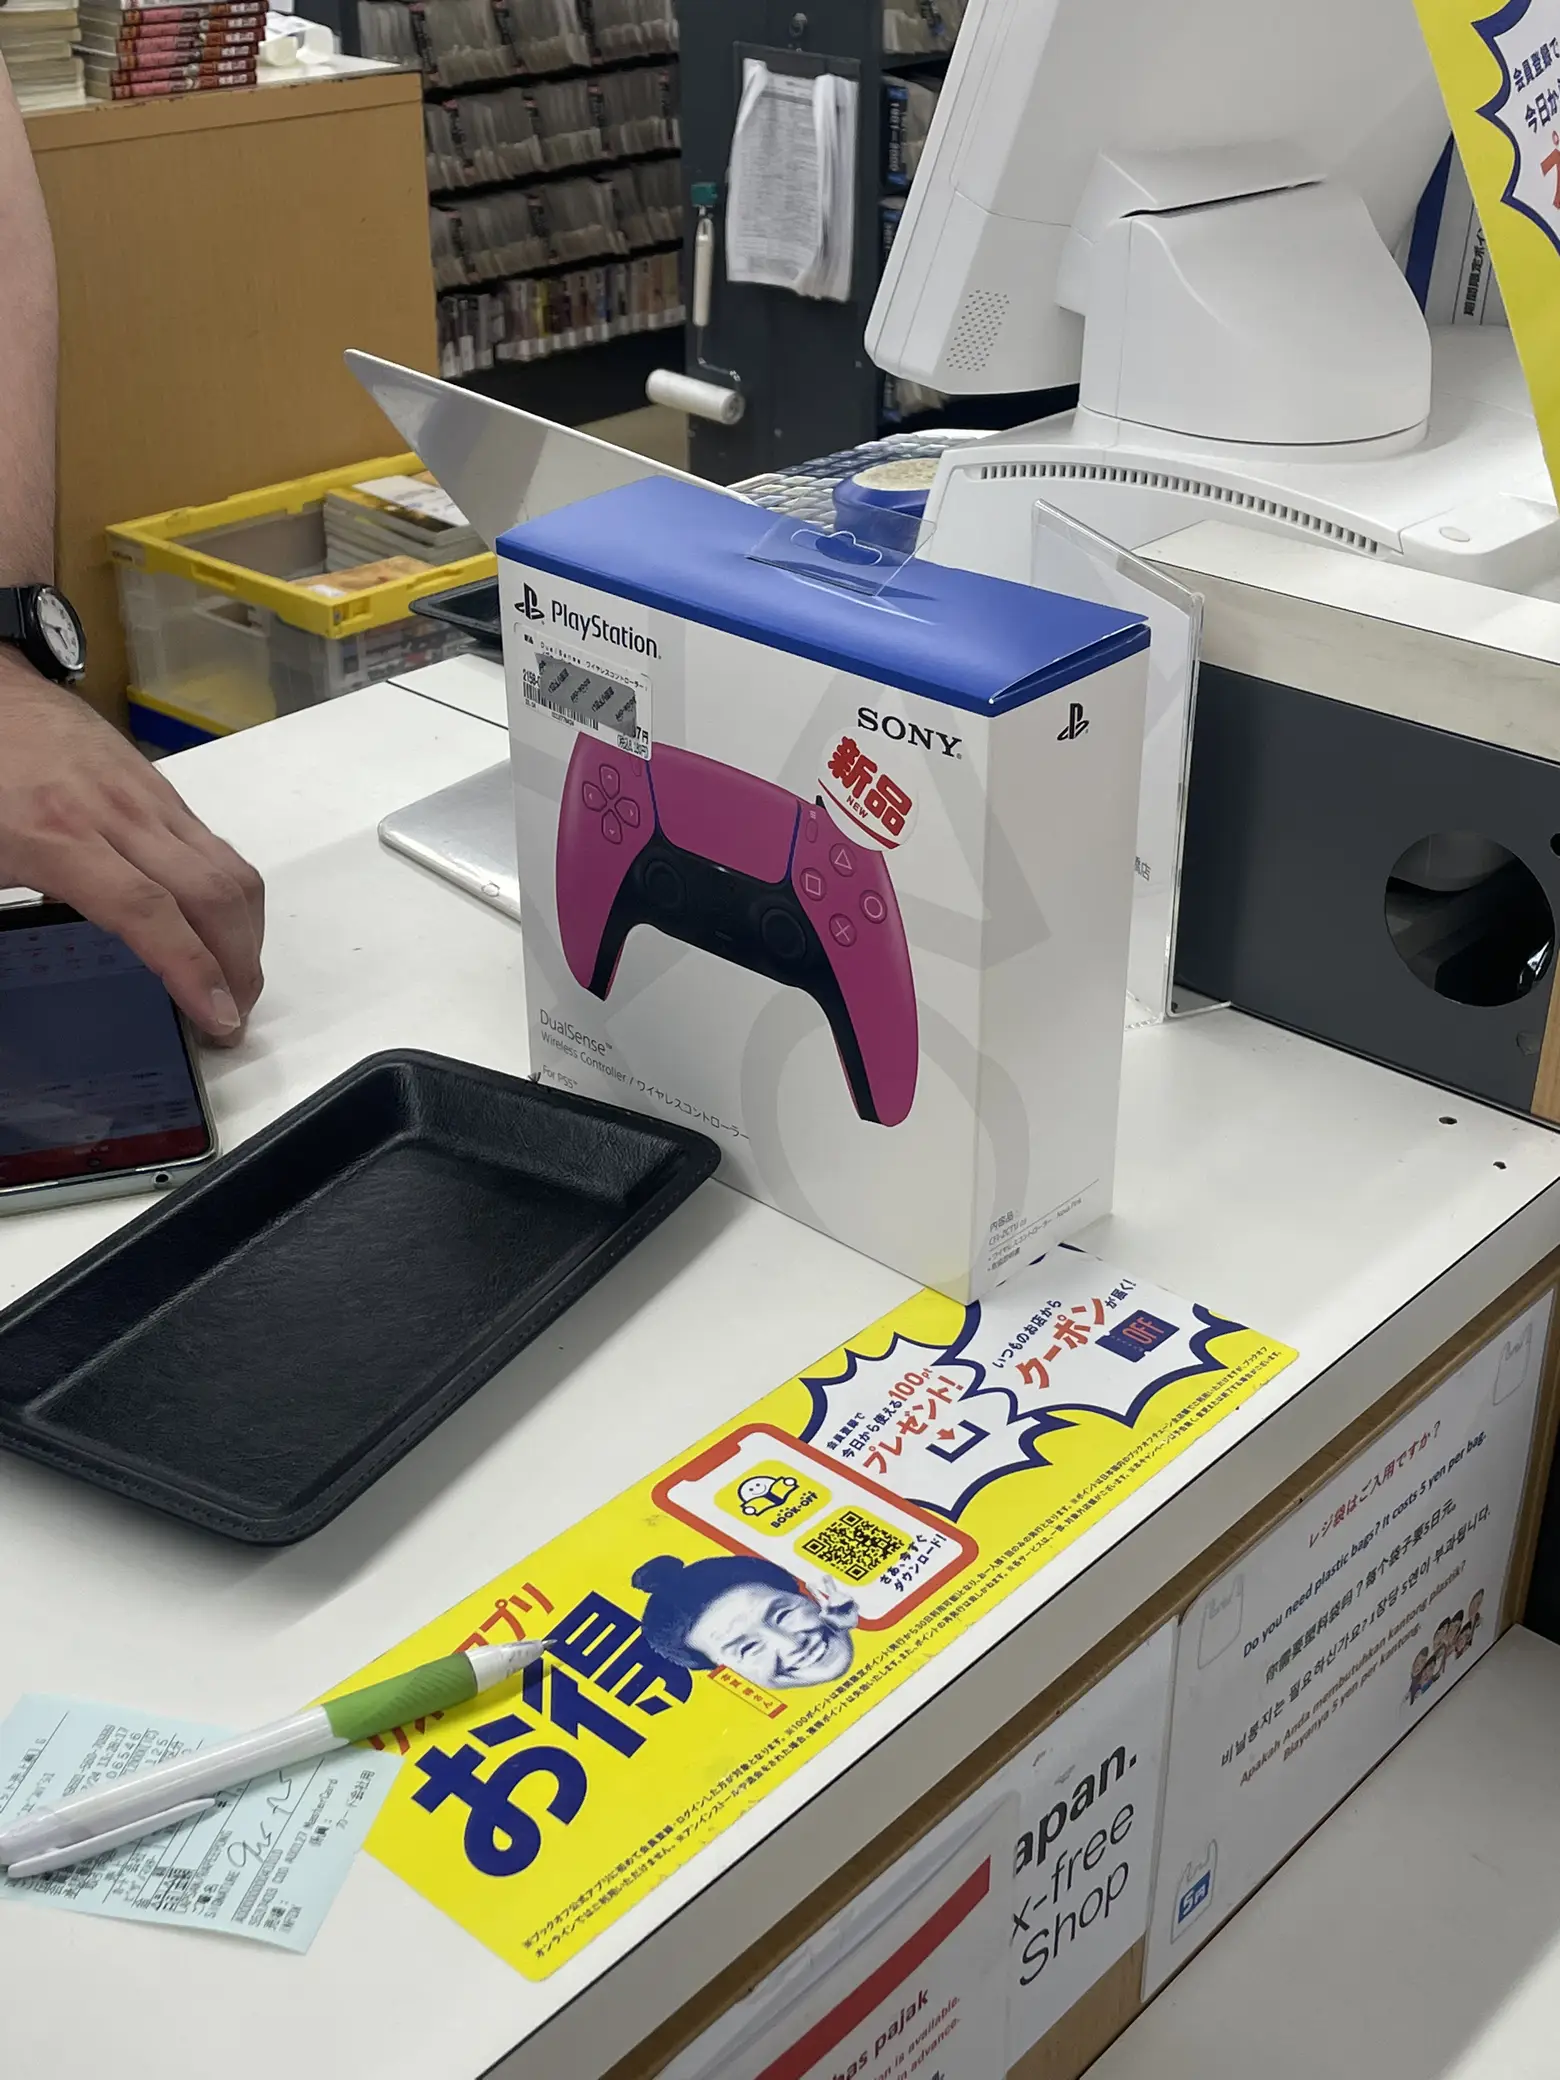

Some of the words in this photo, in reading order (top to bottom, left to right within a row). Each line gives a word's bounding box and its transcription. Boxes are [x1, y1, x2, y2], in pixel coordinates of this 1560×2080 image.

[1525, 78, 1560, 133] 今日か
[1463, 226, 1486, 316] 期間限定ポイ
[551, 599, 660, 660] PlayStation
[857, 706, 962, 758] SONY
[827, 735, 913, 837] 新品
[846, 793, 869, 819] NEW
[540, 1030, 578, 1060] Wireless
[579, 1050, 628, 1084] Controller
[636, 1080, 750, 1140] ワイヤレスコントローラー
[541, 1064, 556, 1081] For
[992, 1300, 1062, 1369] いつものお店から
[1122, 1316, 1165, 1345] OFF
[826, 1412, 866, 1451] 会員登録で
[771, 1491, 819, 1529] BOOK-OFF
[880, 1533, 928, 1585] さあ、今すぐ
[1243, 1638, 1259, 1659] Do
[1261, 1613, 1283, 1645] you
[1285, 1582, 1313, 1620] need
[1314, 1549, 1350, 1597] plastic
[1351, 1521, 1380, 1558] bags?
[1391, 1490, 1418, 1521] costs
[1419, 1480, 1428, 1496] 5
[1428, 1464, 1446, 1491] yen
[1447, 1447, 1466, 1474] per
[1466, 1430, 1487, 1456] bag.
[1239, 1740, 1281, 1788] Apakah
[1283, 1709, 1312, 1745] Anda
[1388, 1594, 1429, 1639] kantong
[1282, 1708, 1331, 1763] Biayanya
[1339, 1680, 1359, 1708] yen
[1359, 1661, 1379, 1690] per
[411, 1590, 693, 1877] お得
[1020, 1862, 1130, 1987] Shop
[874, 1988, 929, 2060] pajak
[908, 1996, 961, 2054] available.
[911, 2017, 962, 2073] advance.
